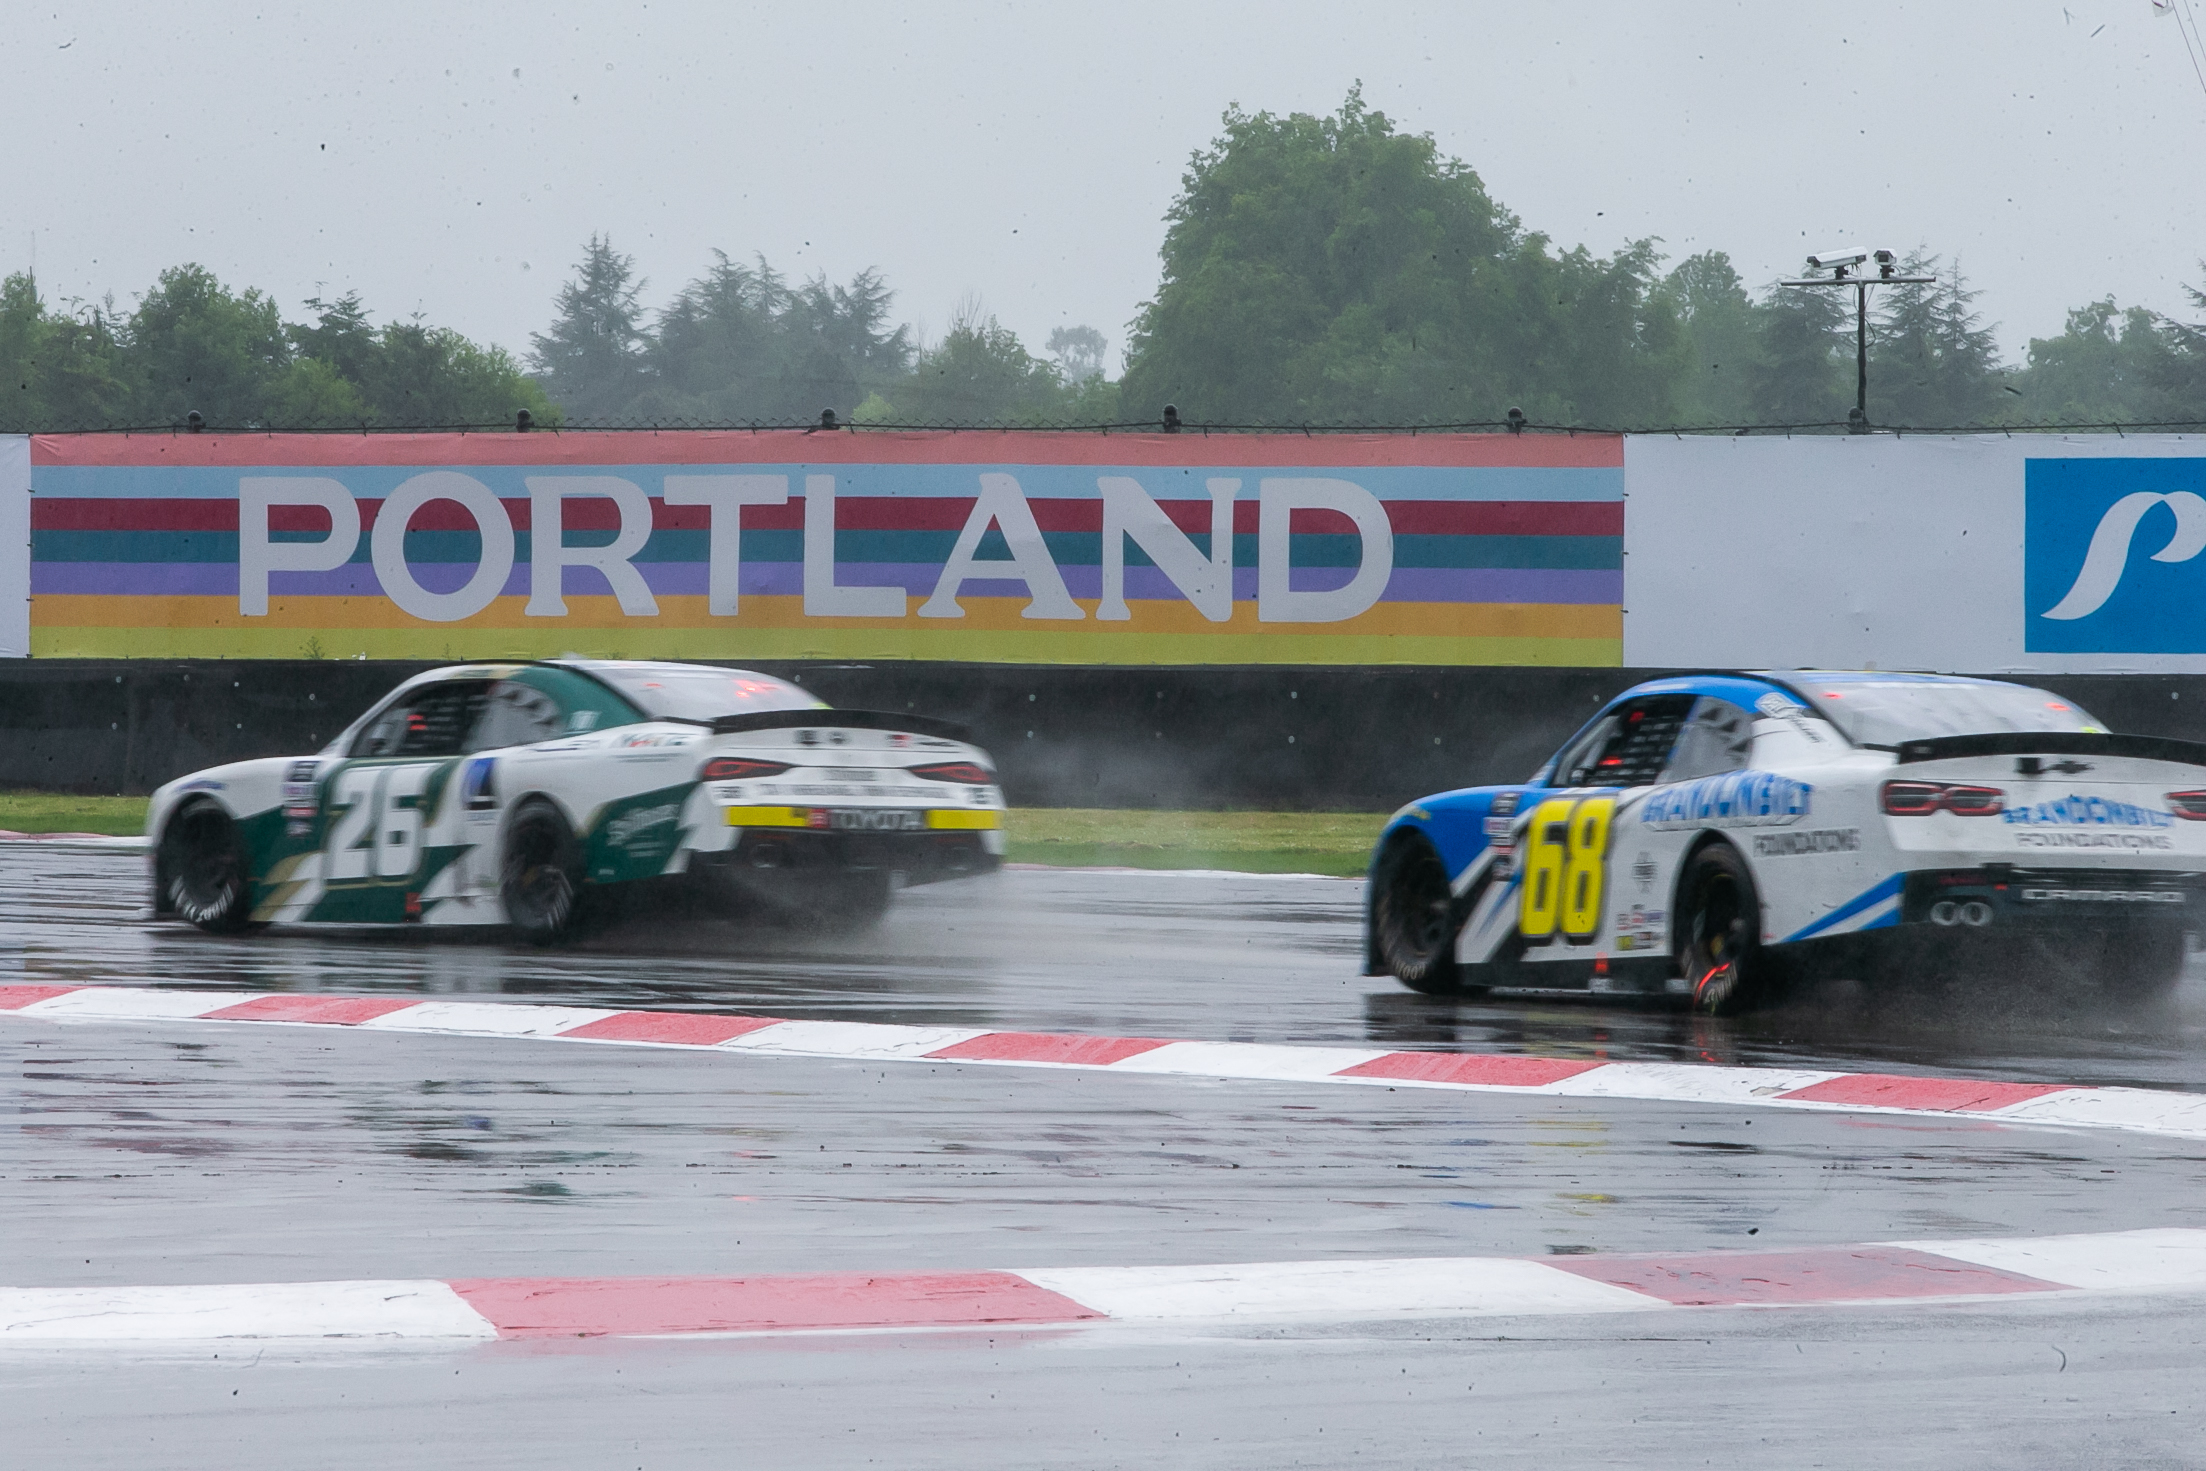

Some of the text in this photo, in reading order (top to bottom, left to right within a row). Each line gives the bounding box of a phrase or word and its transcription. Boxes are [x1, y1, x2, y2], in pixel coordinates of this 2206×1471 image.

[238, 470, 1394, 623] PORTLAND
[324, 763, 440, 880] 26
[1518, 798, 1618, 937] 68
